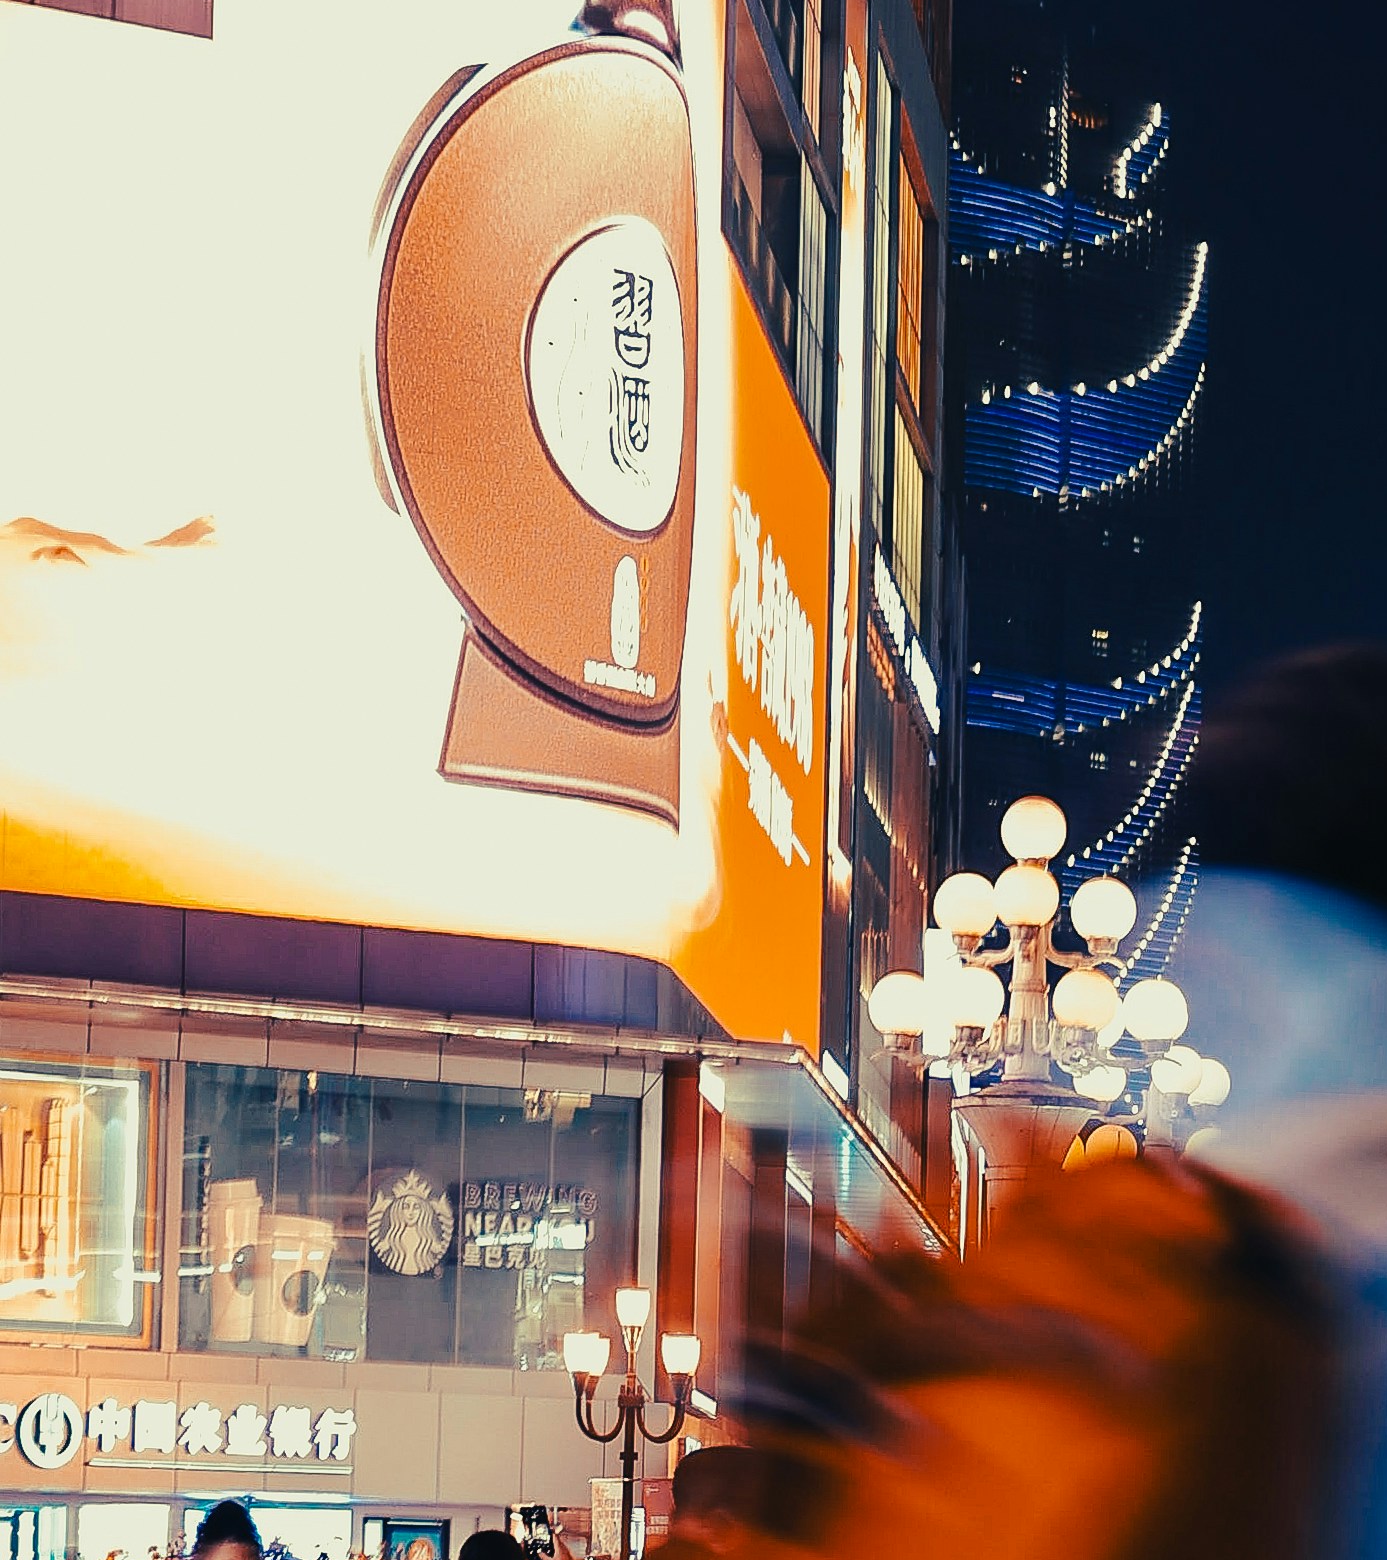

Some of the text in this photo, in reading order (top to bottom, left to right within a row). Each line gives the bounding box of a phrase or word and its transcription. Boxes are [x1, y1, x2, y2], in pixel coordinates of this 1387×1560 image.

[87, 1397, 357, 1461] 中国农业银行
